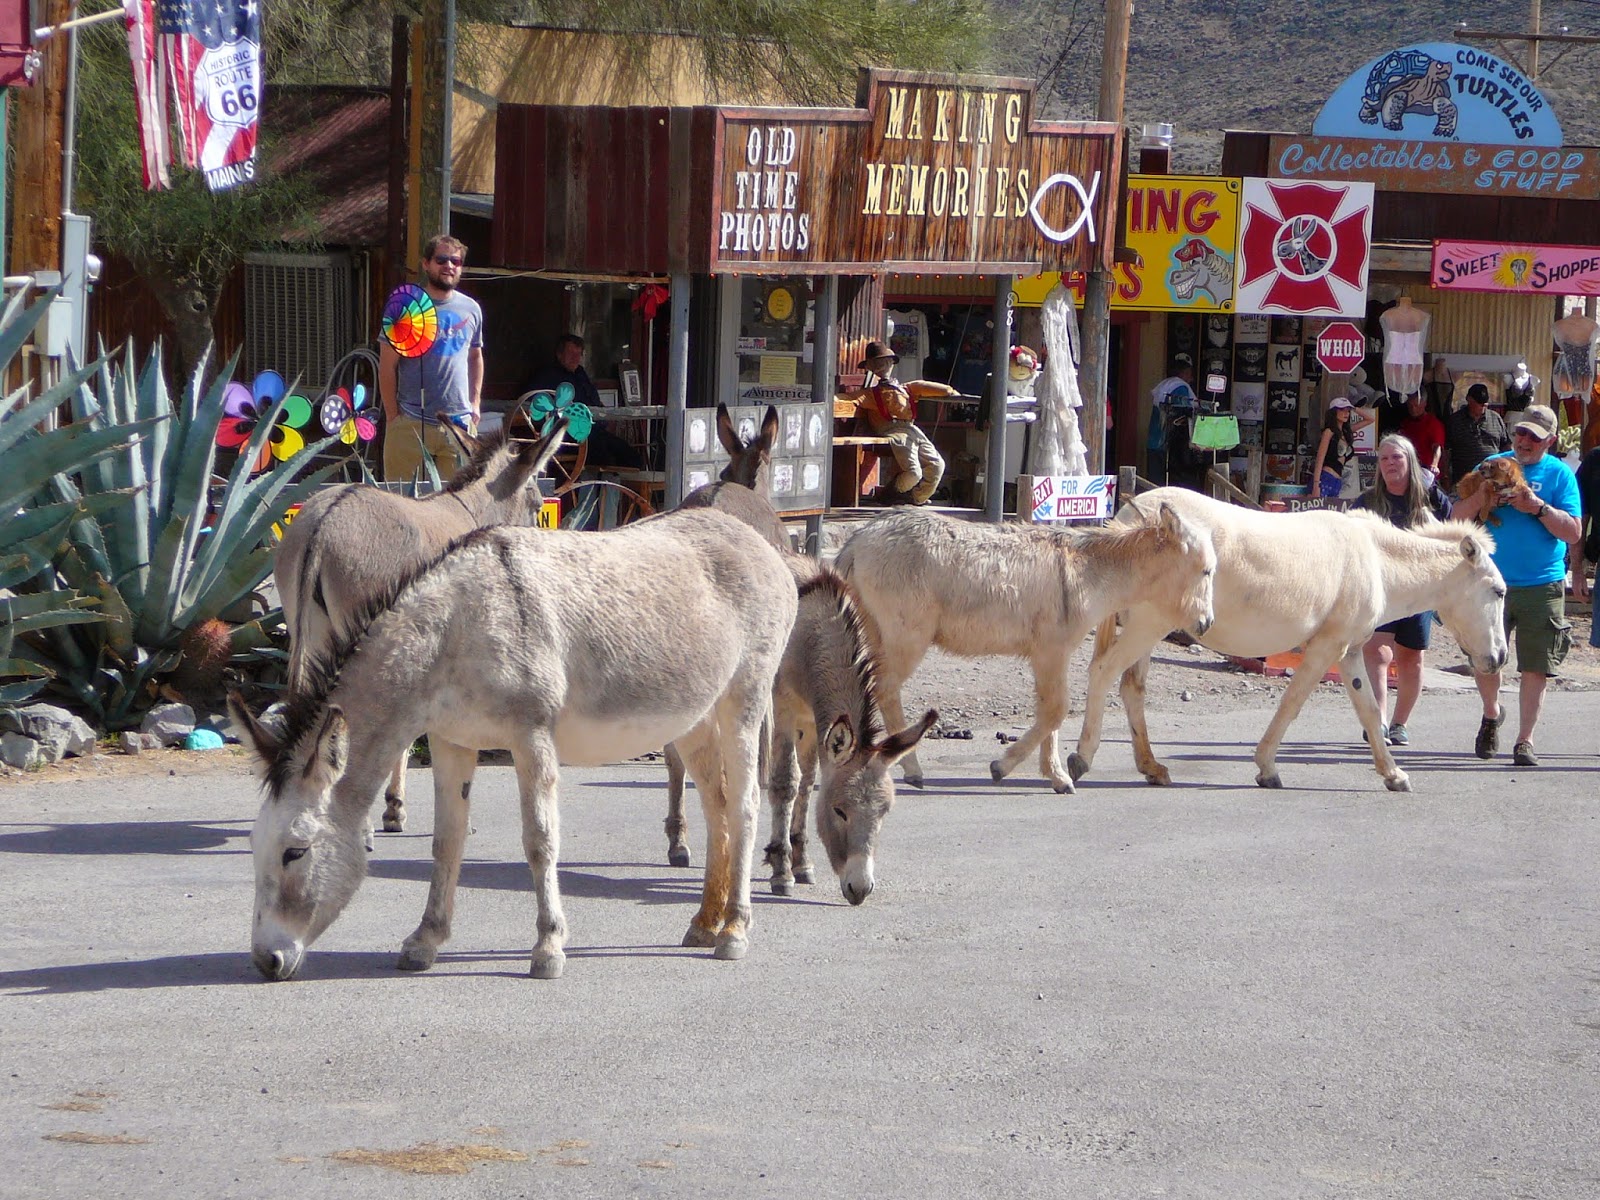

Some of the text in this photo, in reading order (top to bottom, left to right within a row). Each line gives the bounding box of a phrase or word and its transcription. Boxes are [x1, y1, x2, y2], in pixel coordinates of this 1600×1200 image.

[210, 50, 251, 71] HISTORIC
[214, 66, 253, 88] ROUTE
[1456, 50, 1543, 113] COME SEE OUR
[221, 84, 257, 116] 66
[884, 87, 1022, 144] MAKING
[1453, 74, 1534, 139] TURTLES
[746, 127, 796, 167] OLD
[1279, 142, 1585, 175] Collectables & GOOD
[207, 162, 243, 191] MAIN
[736, 171, 798, 210] TIME
[862, 163, 1030, 218] MEMORIES
[1474, 170, 1581, 191] STUFF
[1127, 187, 1221, 235] ING
[719, 211, 810, 252] PHOTOS
[1439, 252, 1600, 289] SWEET SHOPPE
[438, 328, 466, 339] ASA
[1320, 339, 1362, 358] WHOA
[743, 386, 813, 400] America
[1032, 478, 1079, 505] RAY FOR
[1058, 499, 1096, 516] AMERICA
[1290, 498, 1325, 513] READY
